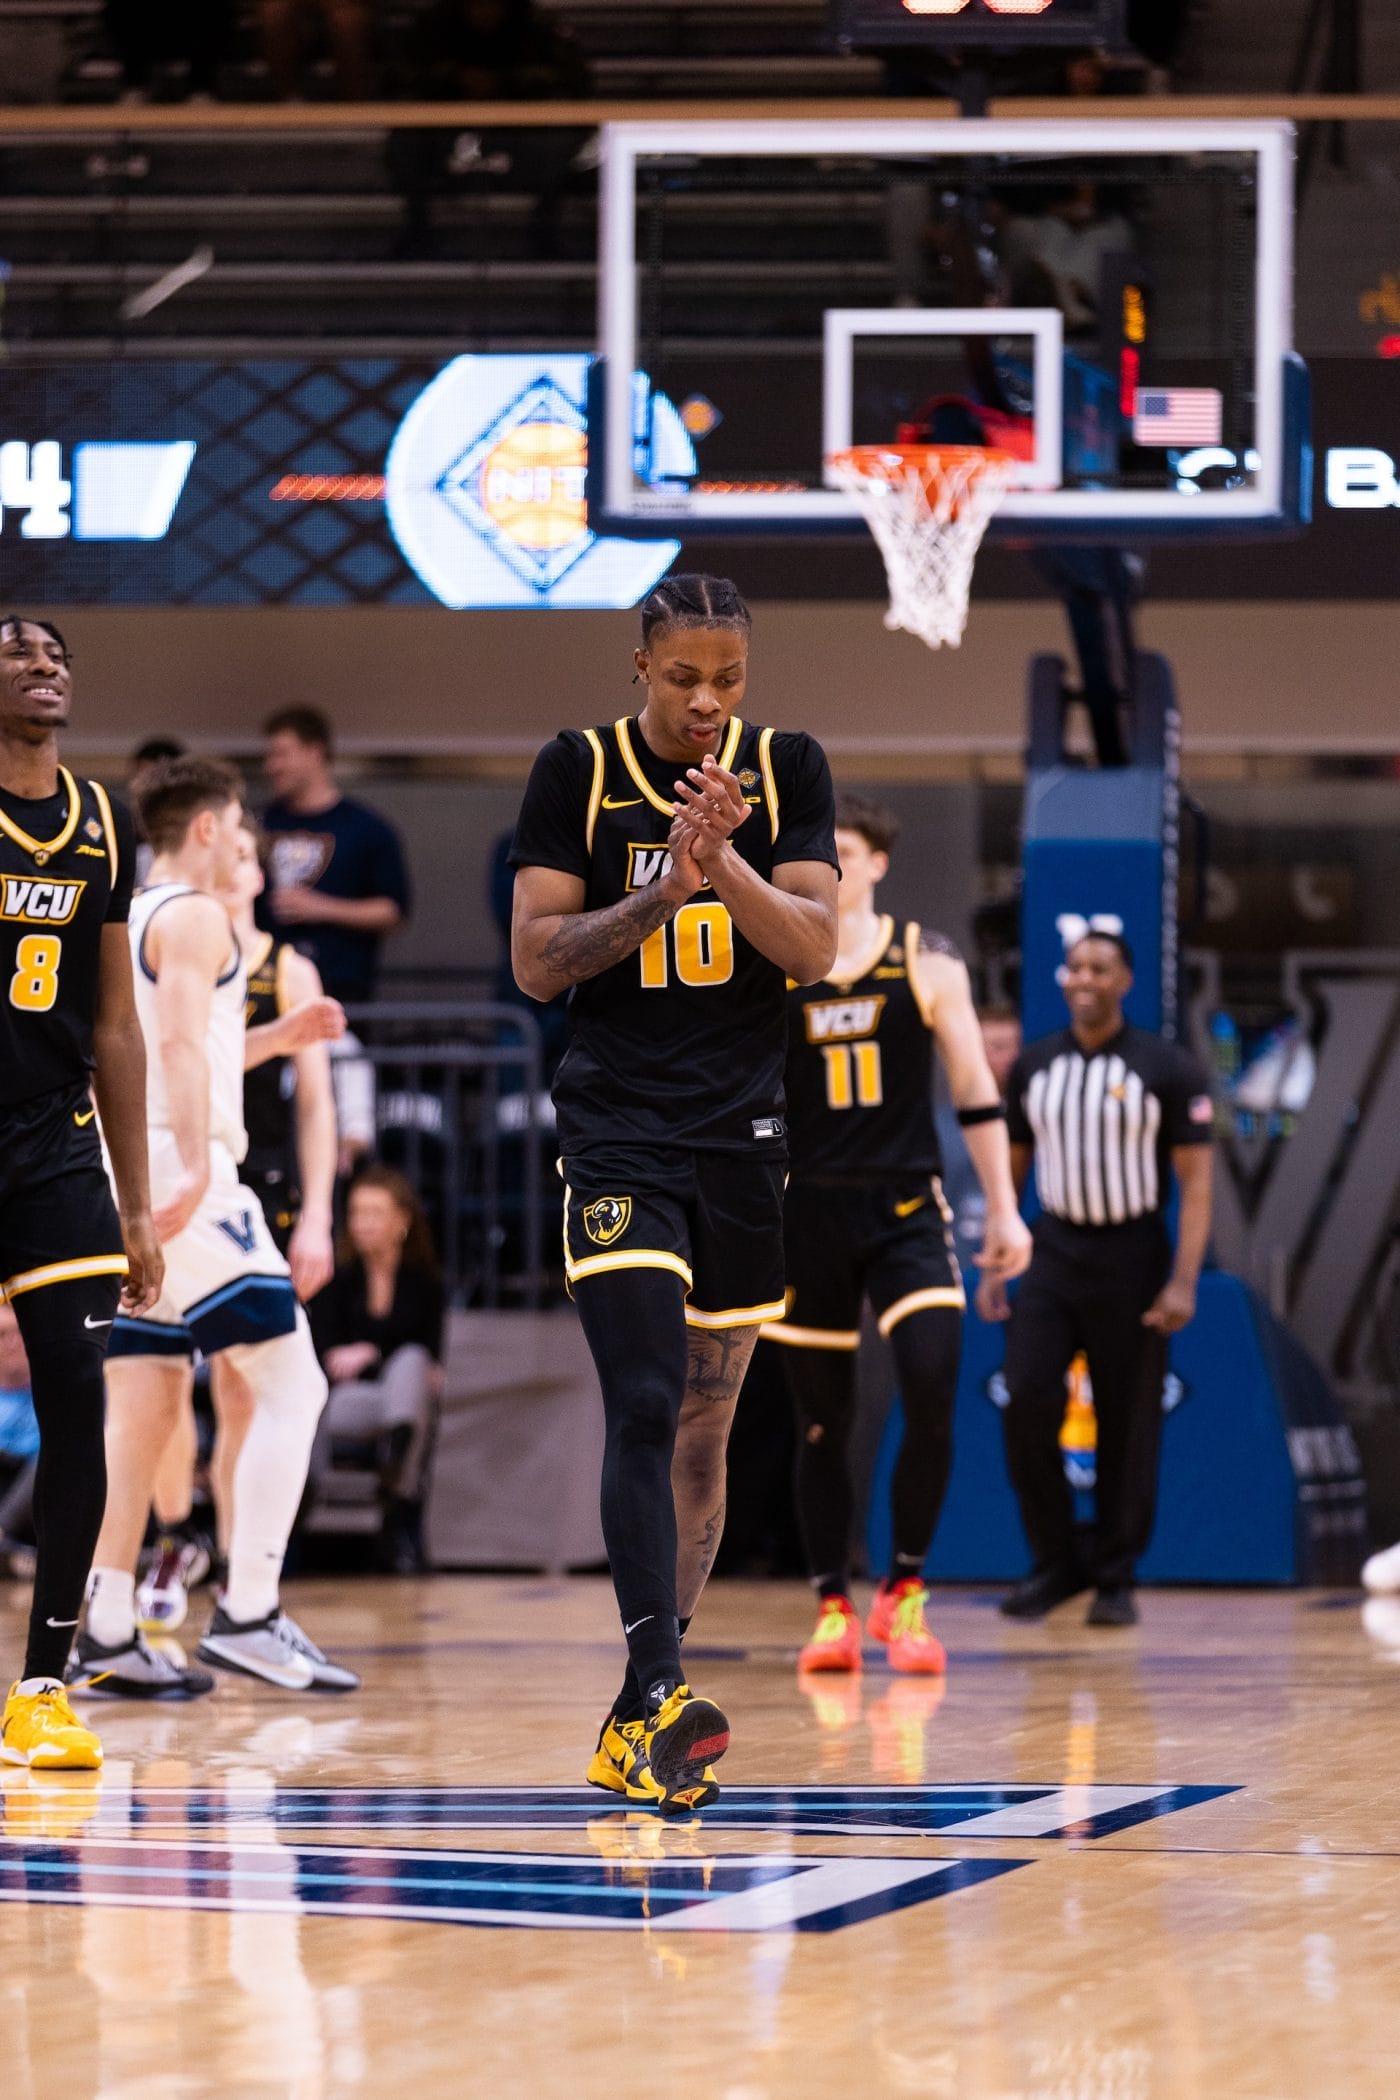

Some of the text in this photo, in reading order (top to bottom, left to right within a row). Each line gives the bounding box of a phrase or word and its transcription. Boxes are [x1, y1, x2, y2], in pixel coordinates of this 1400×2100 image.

[0, 441, 71, 538] 4
[488, 467, 587, 502] NIT
[4, 879, 79, 920] VCU
[9, 934, 62, 1012] 8
[640, 902, 734, 988] 10
[811, 1000, 878, 1040] VCU
[820, 1041, 883, 1110] 11
[215, 1207, 256, 1256] V
